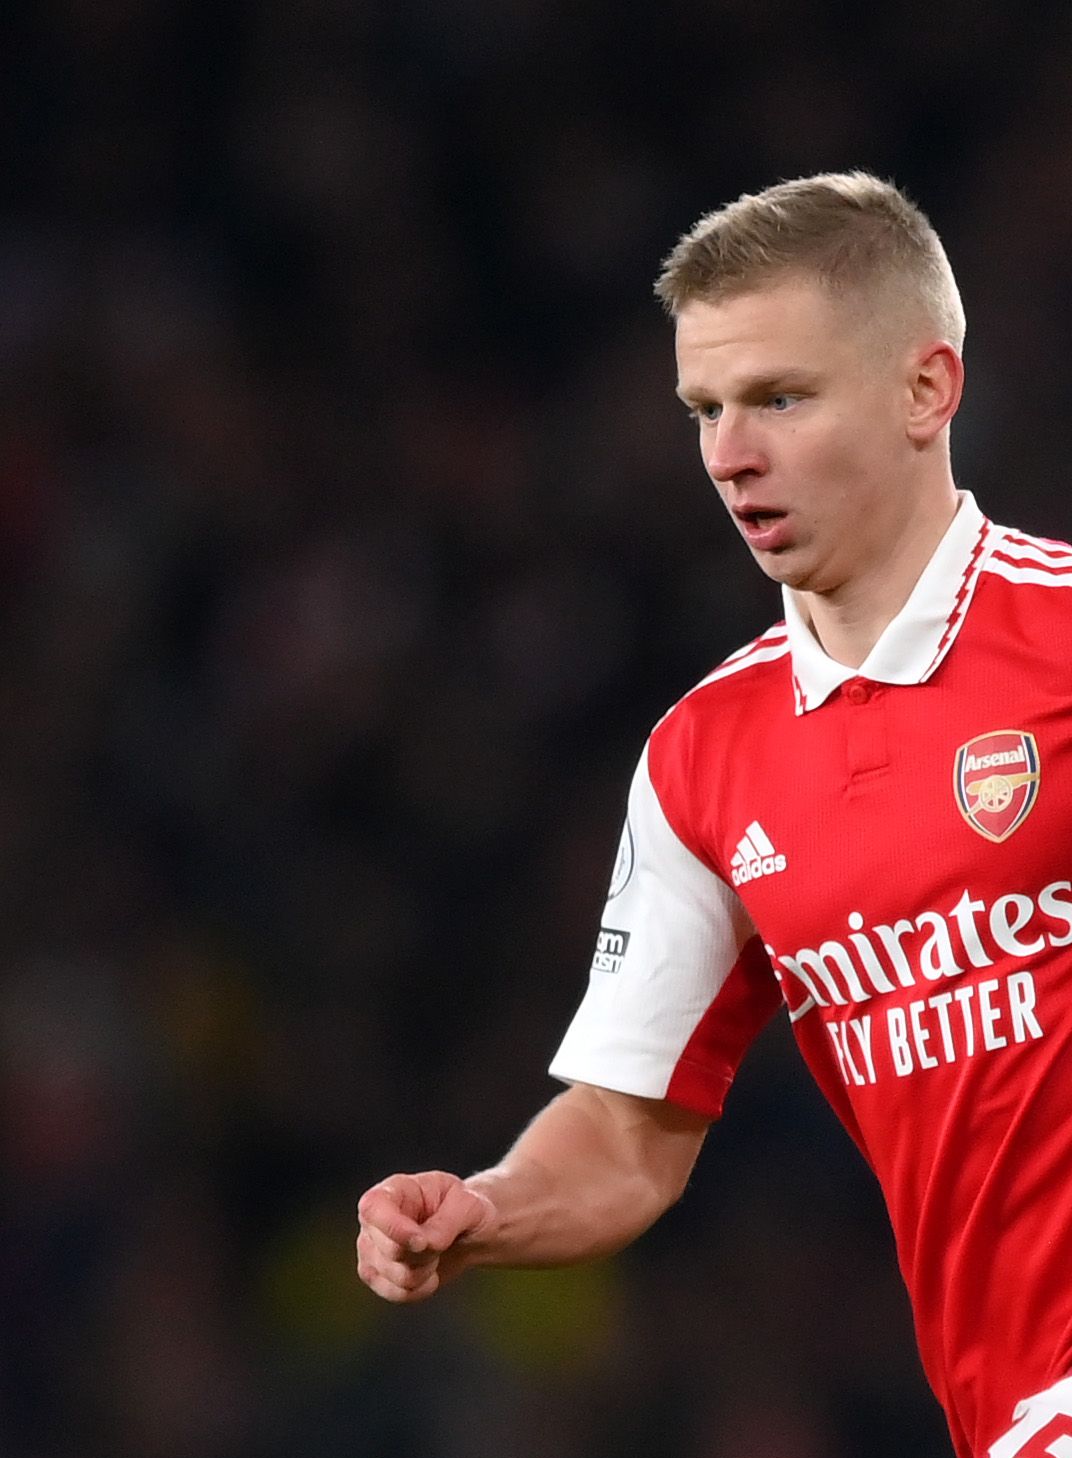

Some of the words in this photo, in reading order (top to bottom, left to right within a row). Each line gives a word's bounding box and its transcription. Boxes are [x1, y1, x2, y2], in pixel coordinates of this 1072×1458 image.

[964, 745, 1026, 773] Arsenal
[731, 854, 787, 887] adidas
[826, 1014, 877, 1086] FLY
[887, 971, 1044, 1077] BETTER
